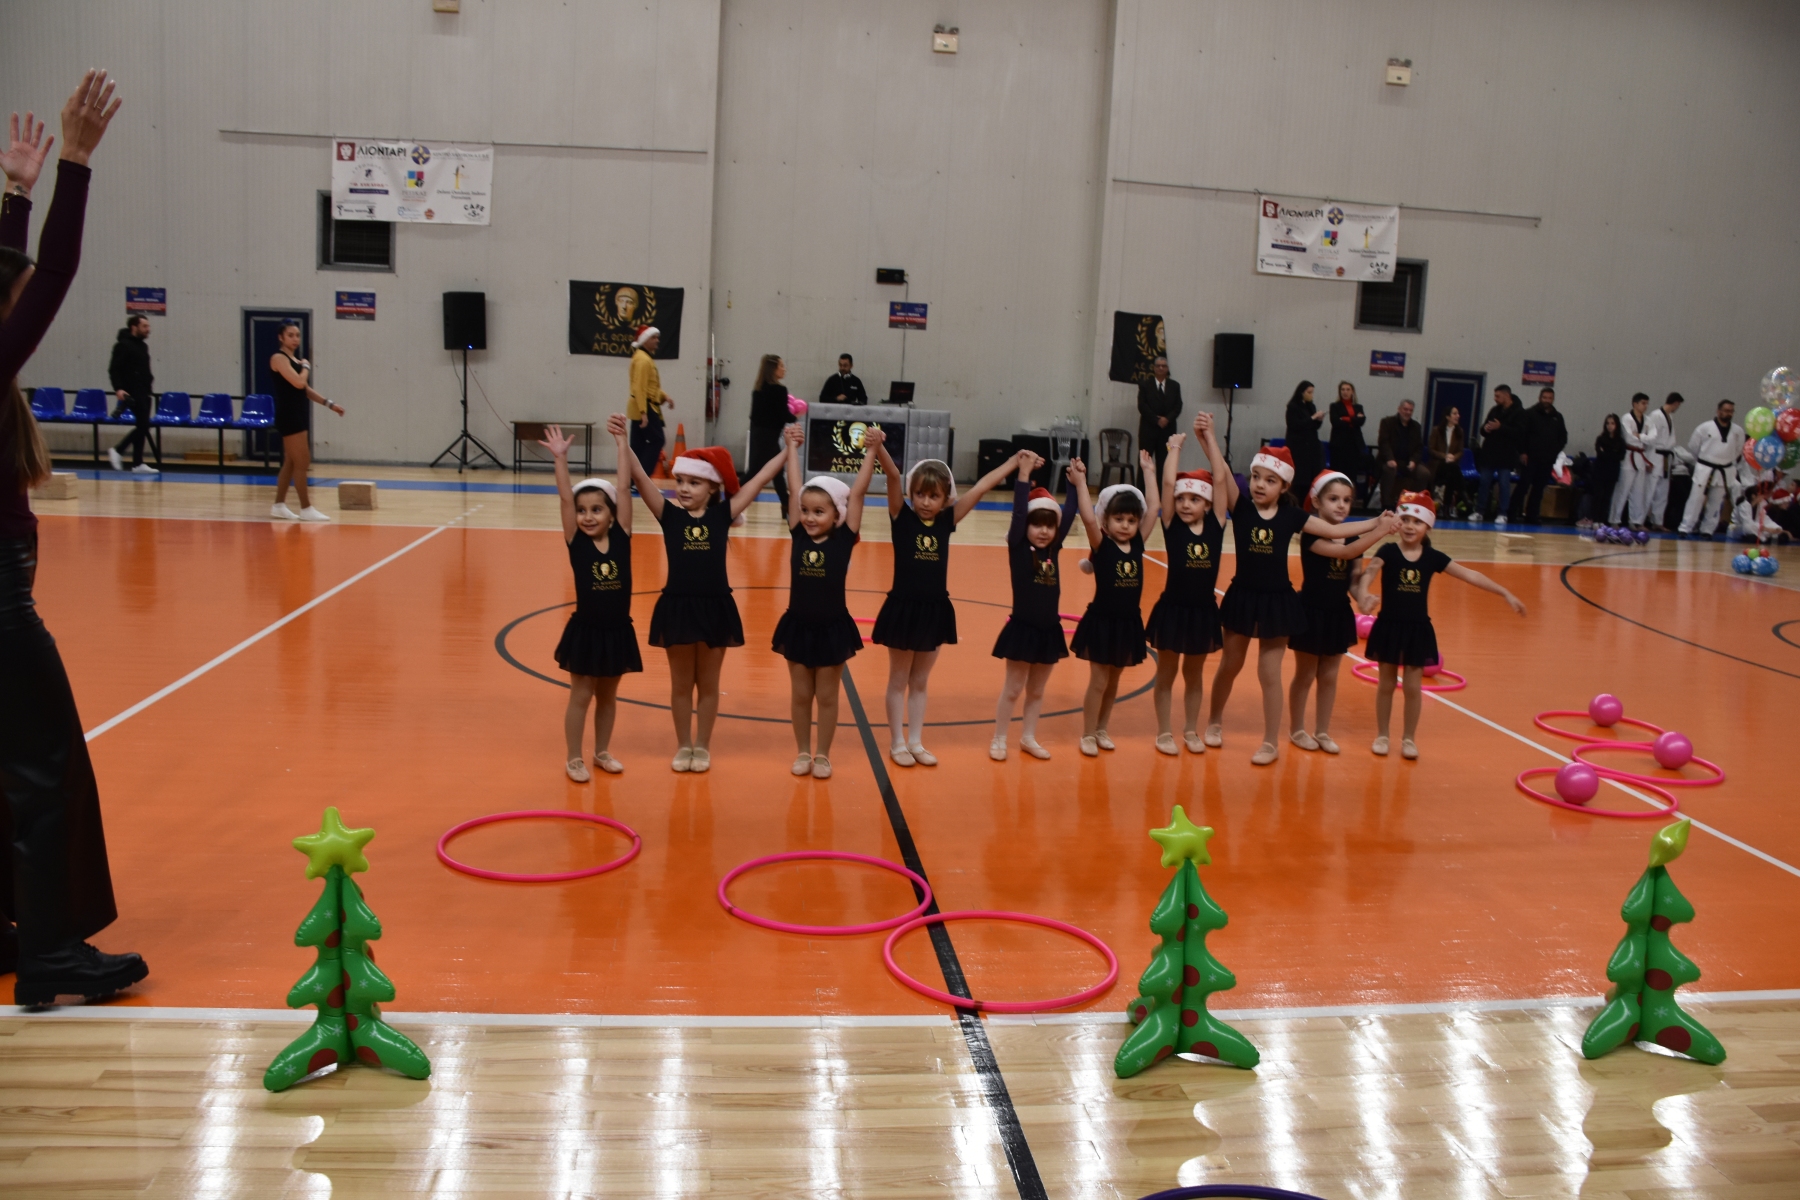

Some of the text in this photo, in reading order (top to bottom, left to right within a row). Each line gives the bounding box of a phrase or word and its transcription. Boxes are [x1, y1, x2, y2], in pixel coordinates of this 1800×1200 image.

[357, 145, 407, 157] ΛΙΟΝΤΑΡΙ
[463, 203, 485, 212] CAFE
[1279, 207, 1324, 219] ΛΙΟΝΤΑΡΙ
